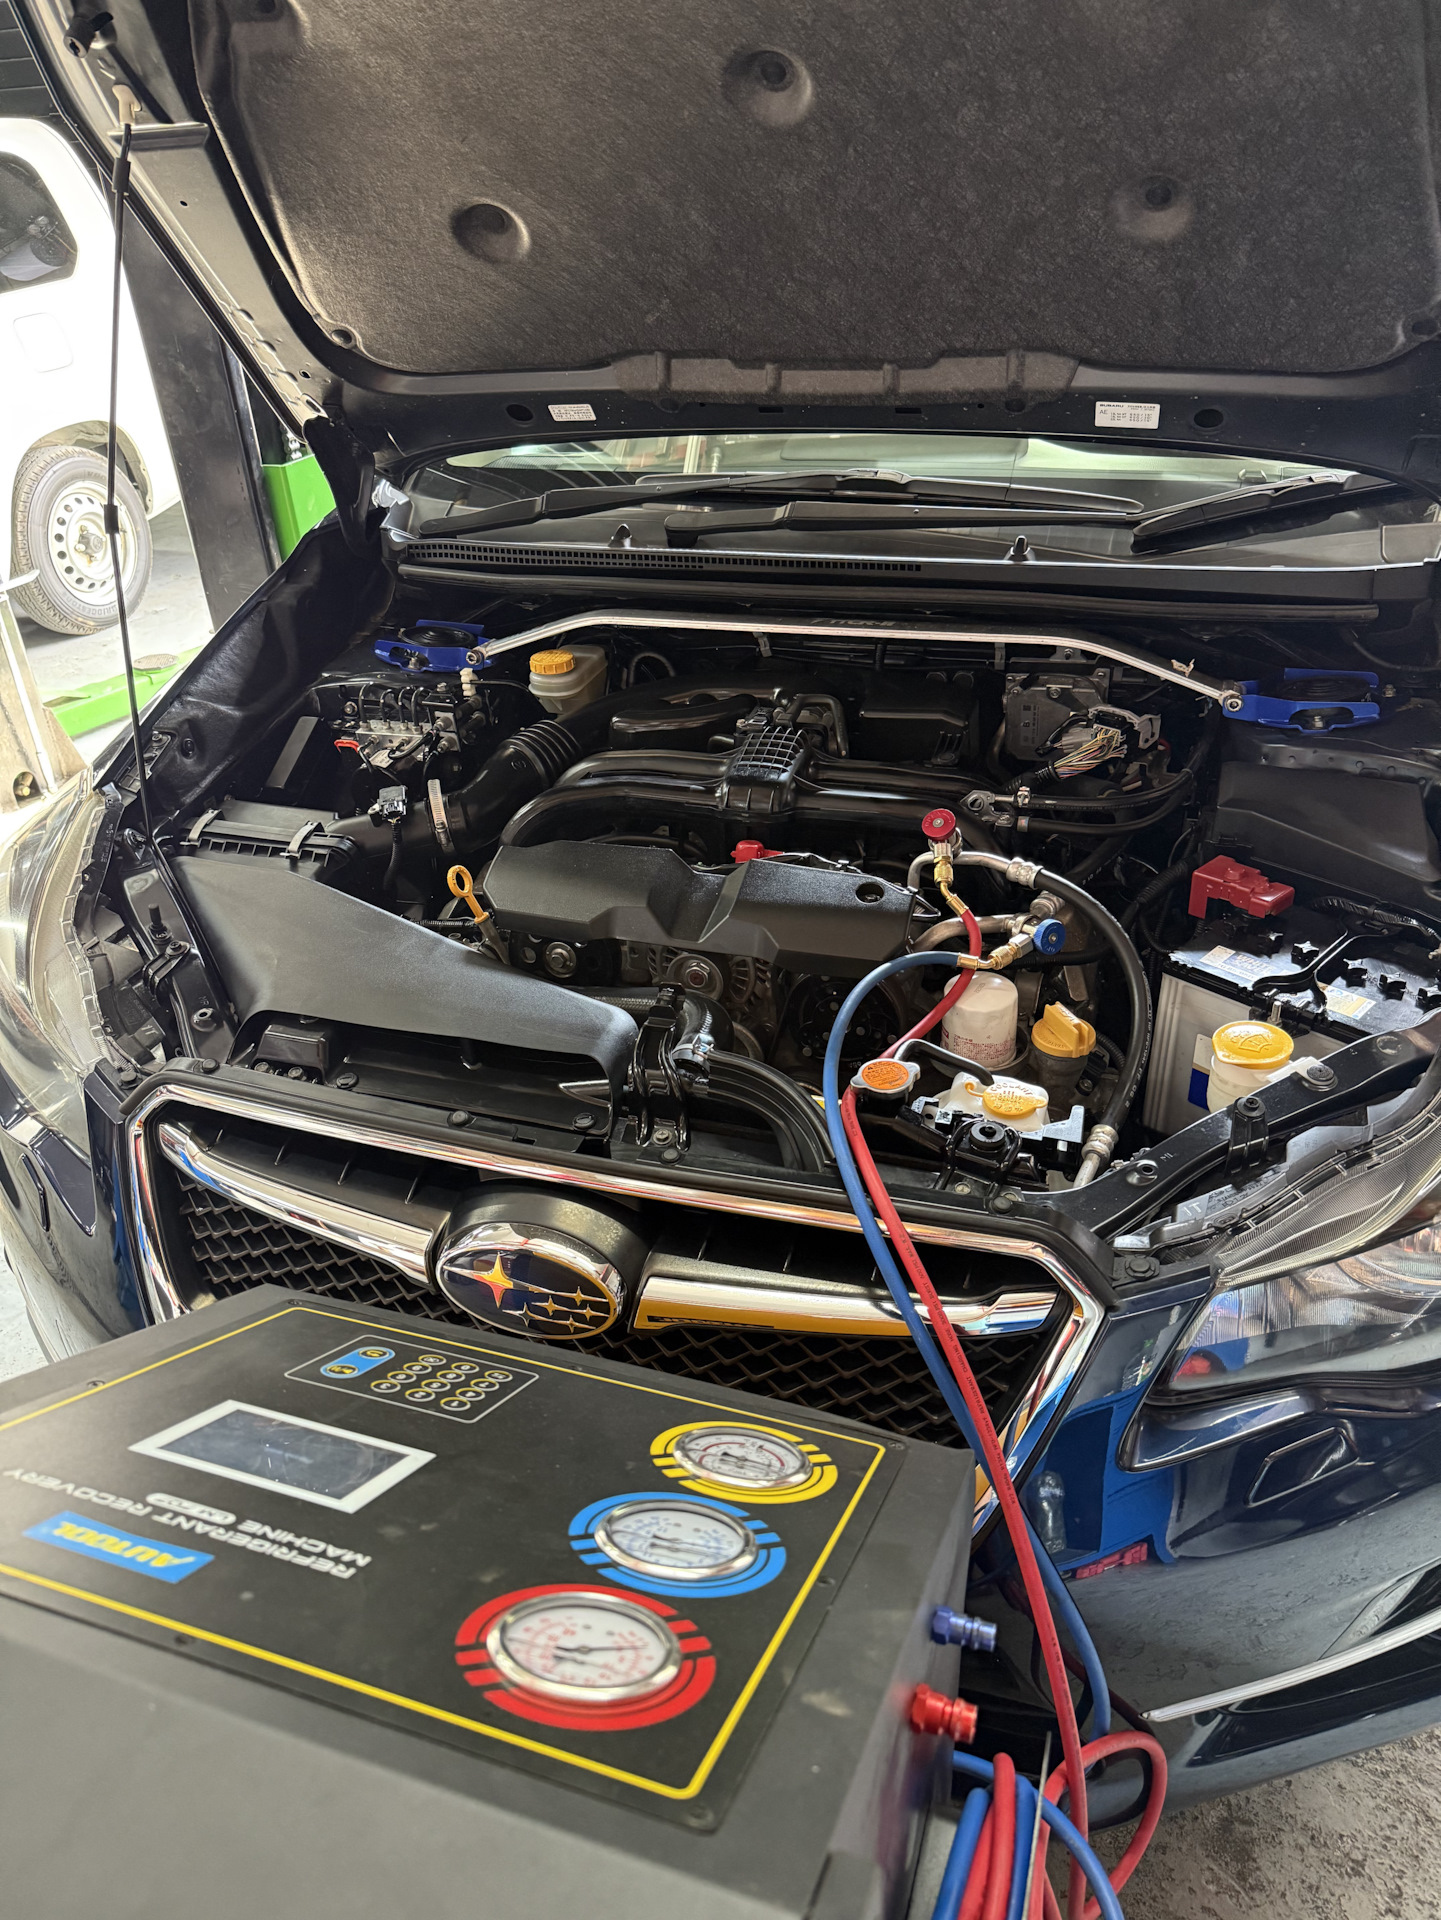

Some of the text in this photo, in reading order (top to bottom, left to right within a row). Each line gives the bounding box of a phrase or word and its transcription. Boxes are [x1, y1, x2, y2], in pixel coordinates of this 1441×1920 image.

[3, 1468, 357, 1579] REFRIGERANT RECOVERY
[237, 1519, 372, 1567] MACHINE
